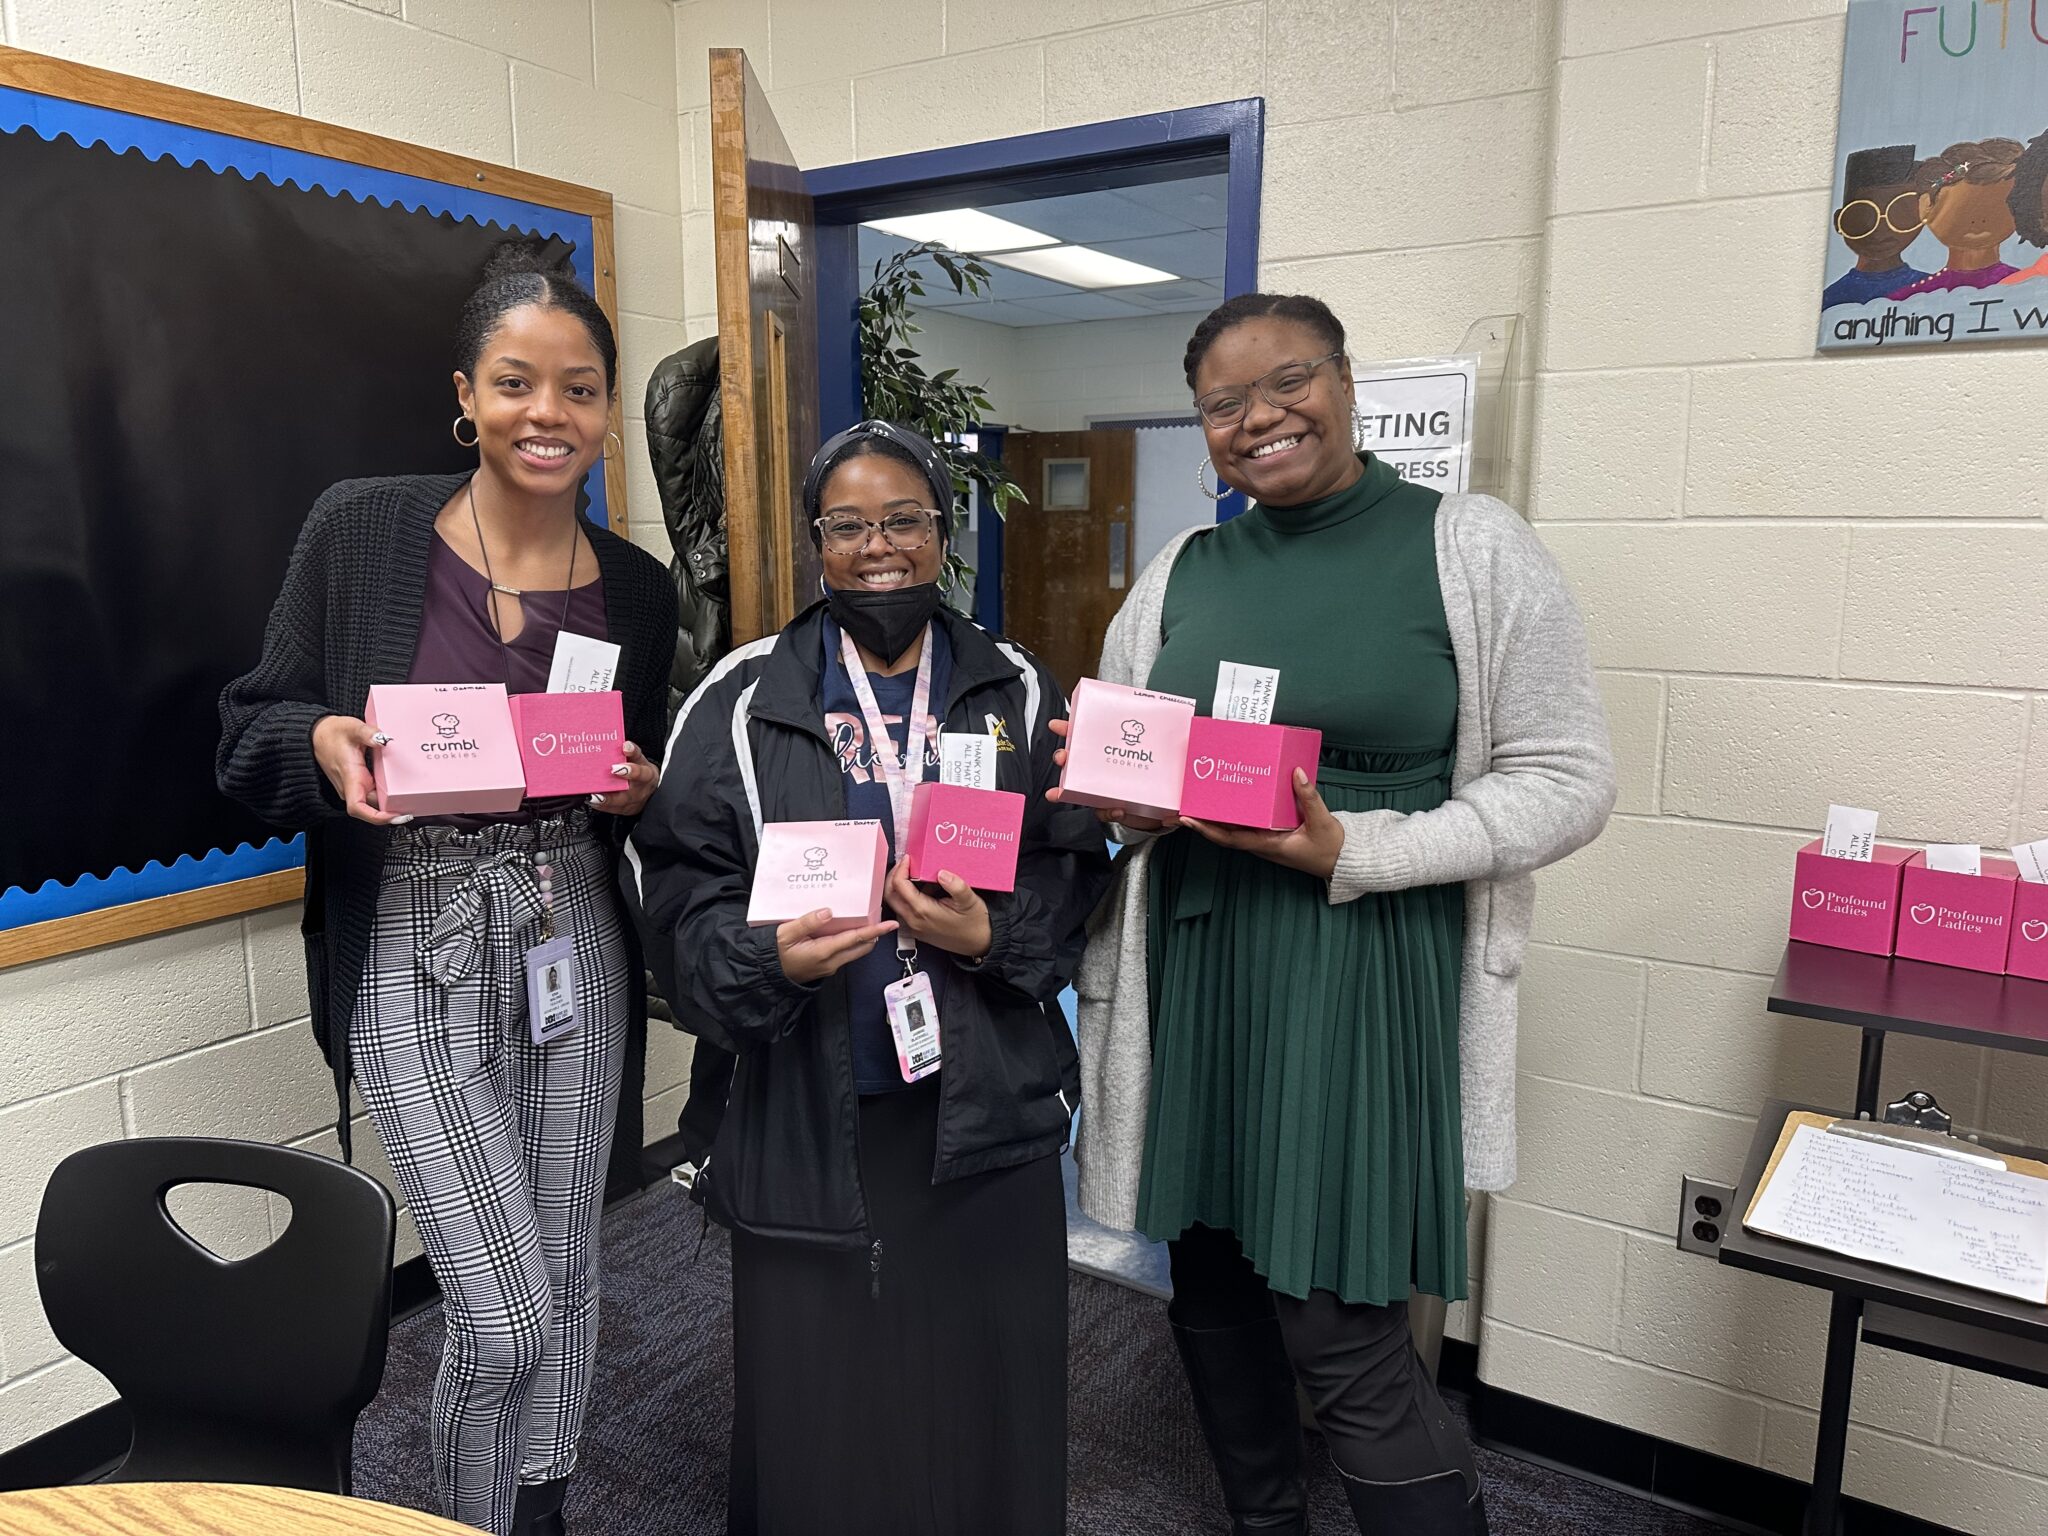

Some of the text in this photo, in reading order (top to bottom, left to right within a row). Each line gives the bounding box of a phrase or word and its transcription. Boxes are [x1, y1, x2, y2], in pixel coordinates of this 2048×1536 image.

[1834, 305, 1955, 345] anything
[1966, 299, 2004, 334] I
[1261, 675, 1274, 706] THANK
[1249, 678, 1262, 720] ALL THAT
[559, 729, 618, 743] Profound
[421, 739, 479, 753] crumbl
[560, 742, 602, 755] Ladies
[964, 743, 972, 759] ALL
[1103, 745, 1154, 763] crumbl
[426, 752, 477, 761] cookies
[973, 740, 982, 788] THANK YOU
[1106, 757, 1149, 771] cookies
[963, 761, 972, 781] THAT
[1217, 758, 1271, 777] Profound
[1215, 770, 1254, 785] Ladies
[959, 824, 1014, 843] Profound
[1850, 834, 1859, 848] ALL
[958, 834, 997, 850] Ladies
[1860, 832, 1871, 859] THANK
[787, 870, 838, 883] crumbl
[789, 881, 834, 890] cookies
[1827, 891, 1887, 910] Profound
[1826, 901, 1868, 918] Ladies
[1938, 906, 2003, 926] Profound
[1937, 917, 1982, 933] Ladies
